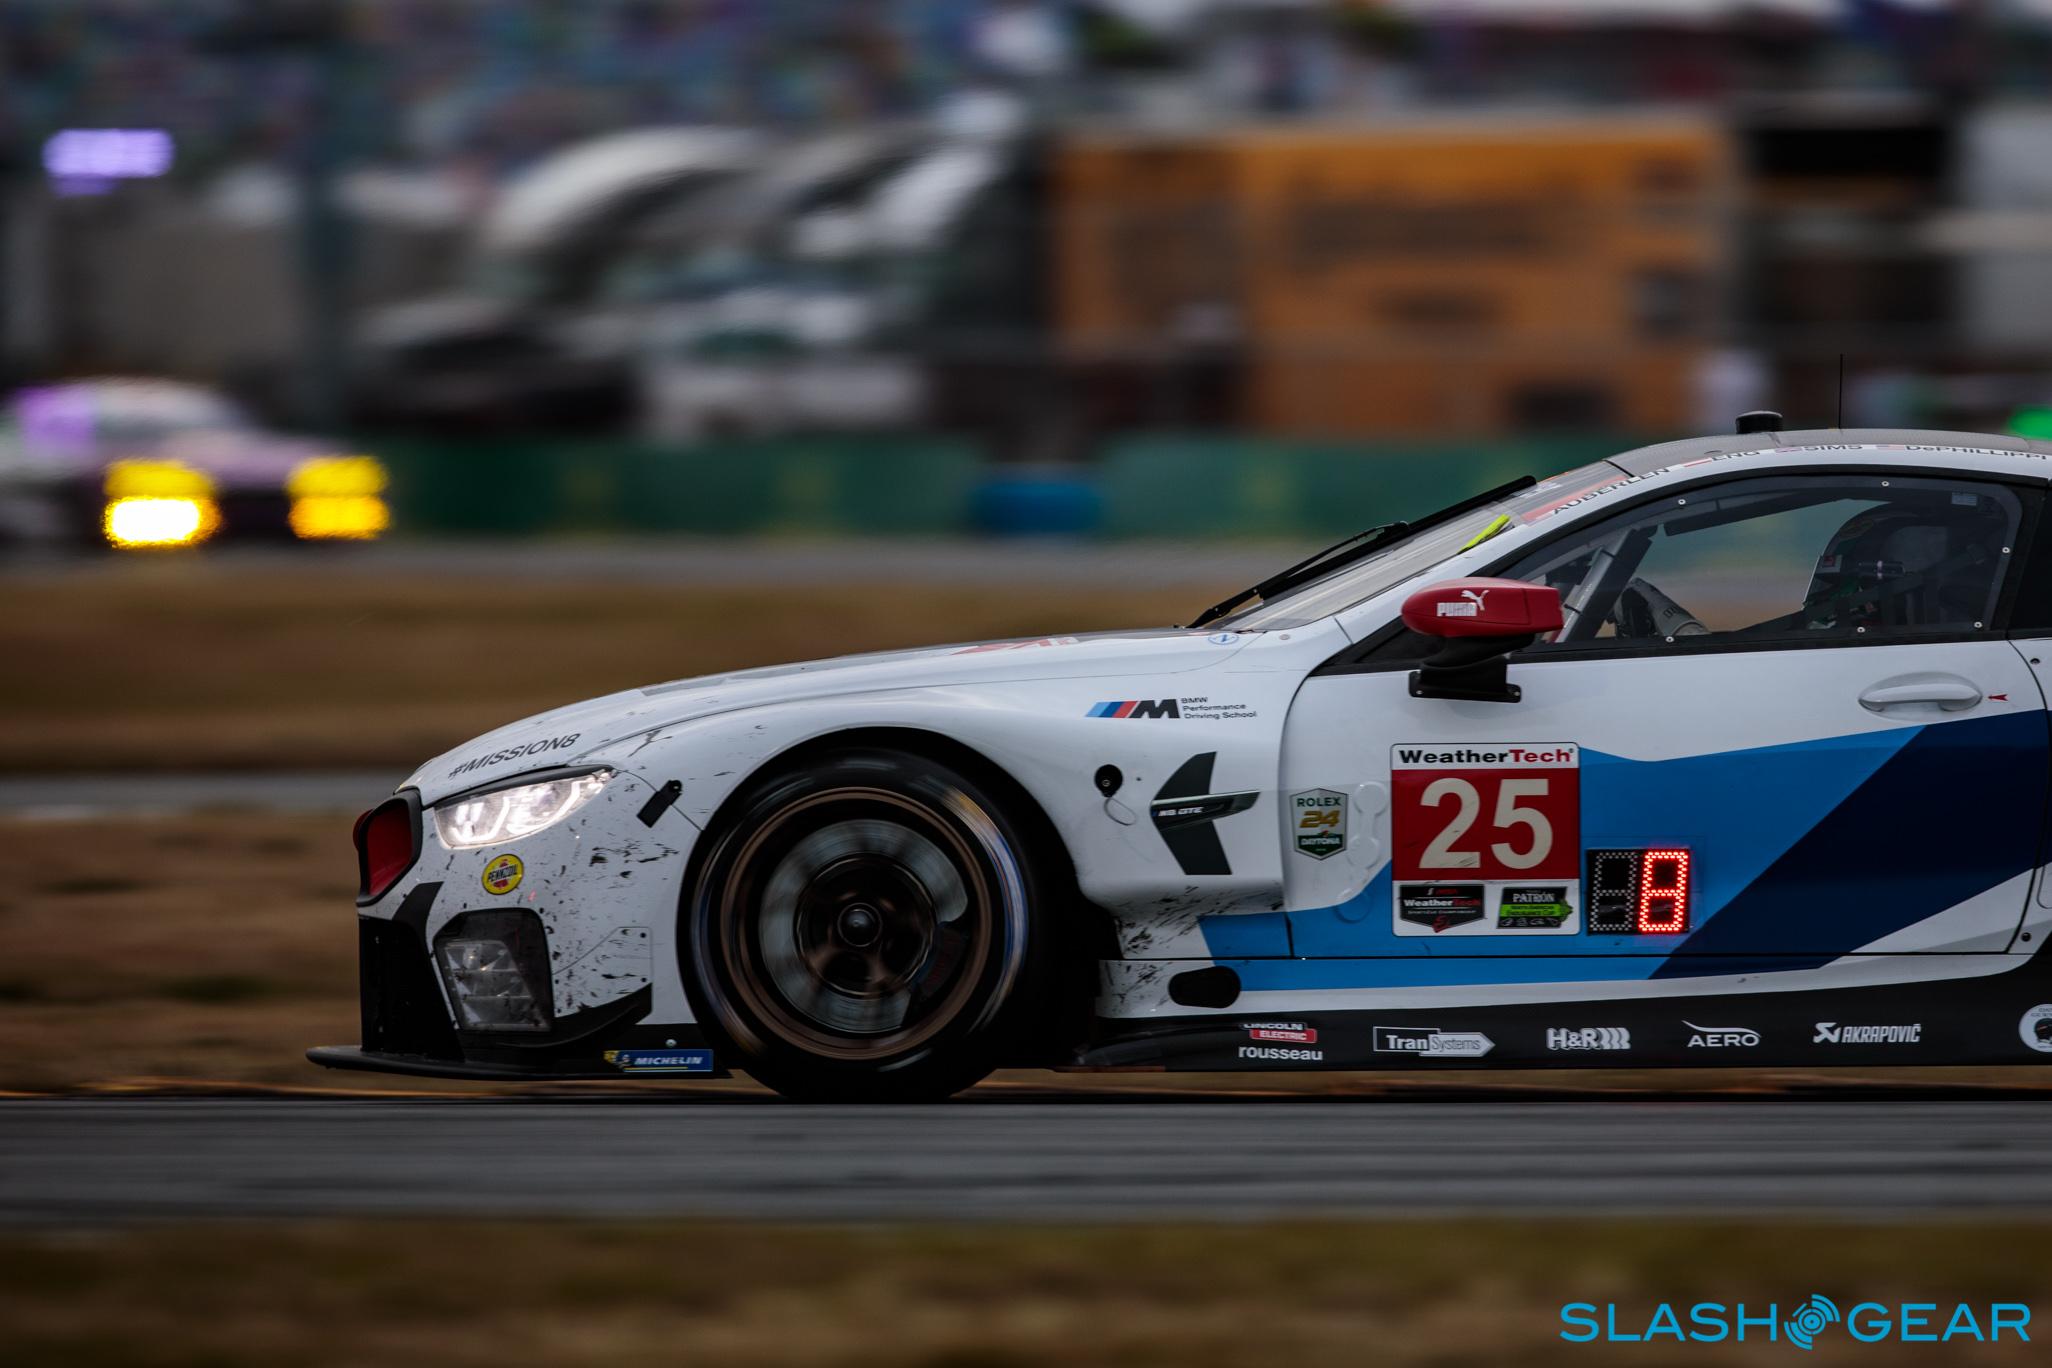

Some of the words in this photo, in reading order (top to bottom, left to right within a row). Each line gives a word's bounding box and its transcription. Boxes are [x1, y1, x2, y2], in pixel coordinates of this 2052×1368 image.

[1181, 696, 1208, 704] BMW
[1182, 703, 1246, 712] Performance
[1184, 712, 1220, 720] Driving
[1222, 710, 1258, 719] School
[448, 733, 581, 779] #MISSION8
[1296, 797, 1341, 807] ROLEX
[1299, 810, 1341, 828] 24
[1418, 777, 1554, 870] 25
[1243, 1023, 1304, 1031] LINCOLN
[1258, 1030, 1308, 1041] ELECTRIC
[1687, 1033, 1760, 1047] AERO
[1238, 1046, 1323, 1061] rousseau
[634, 1056, 703, 1065] MICHELIN
